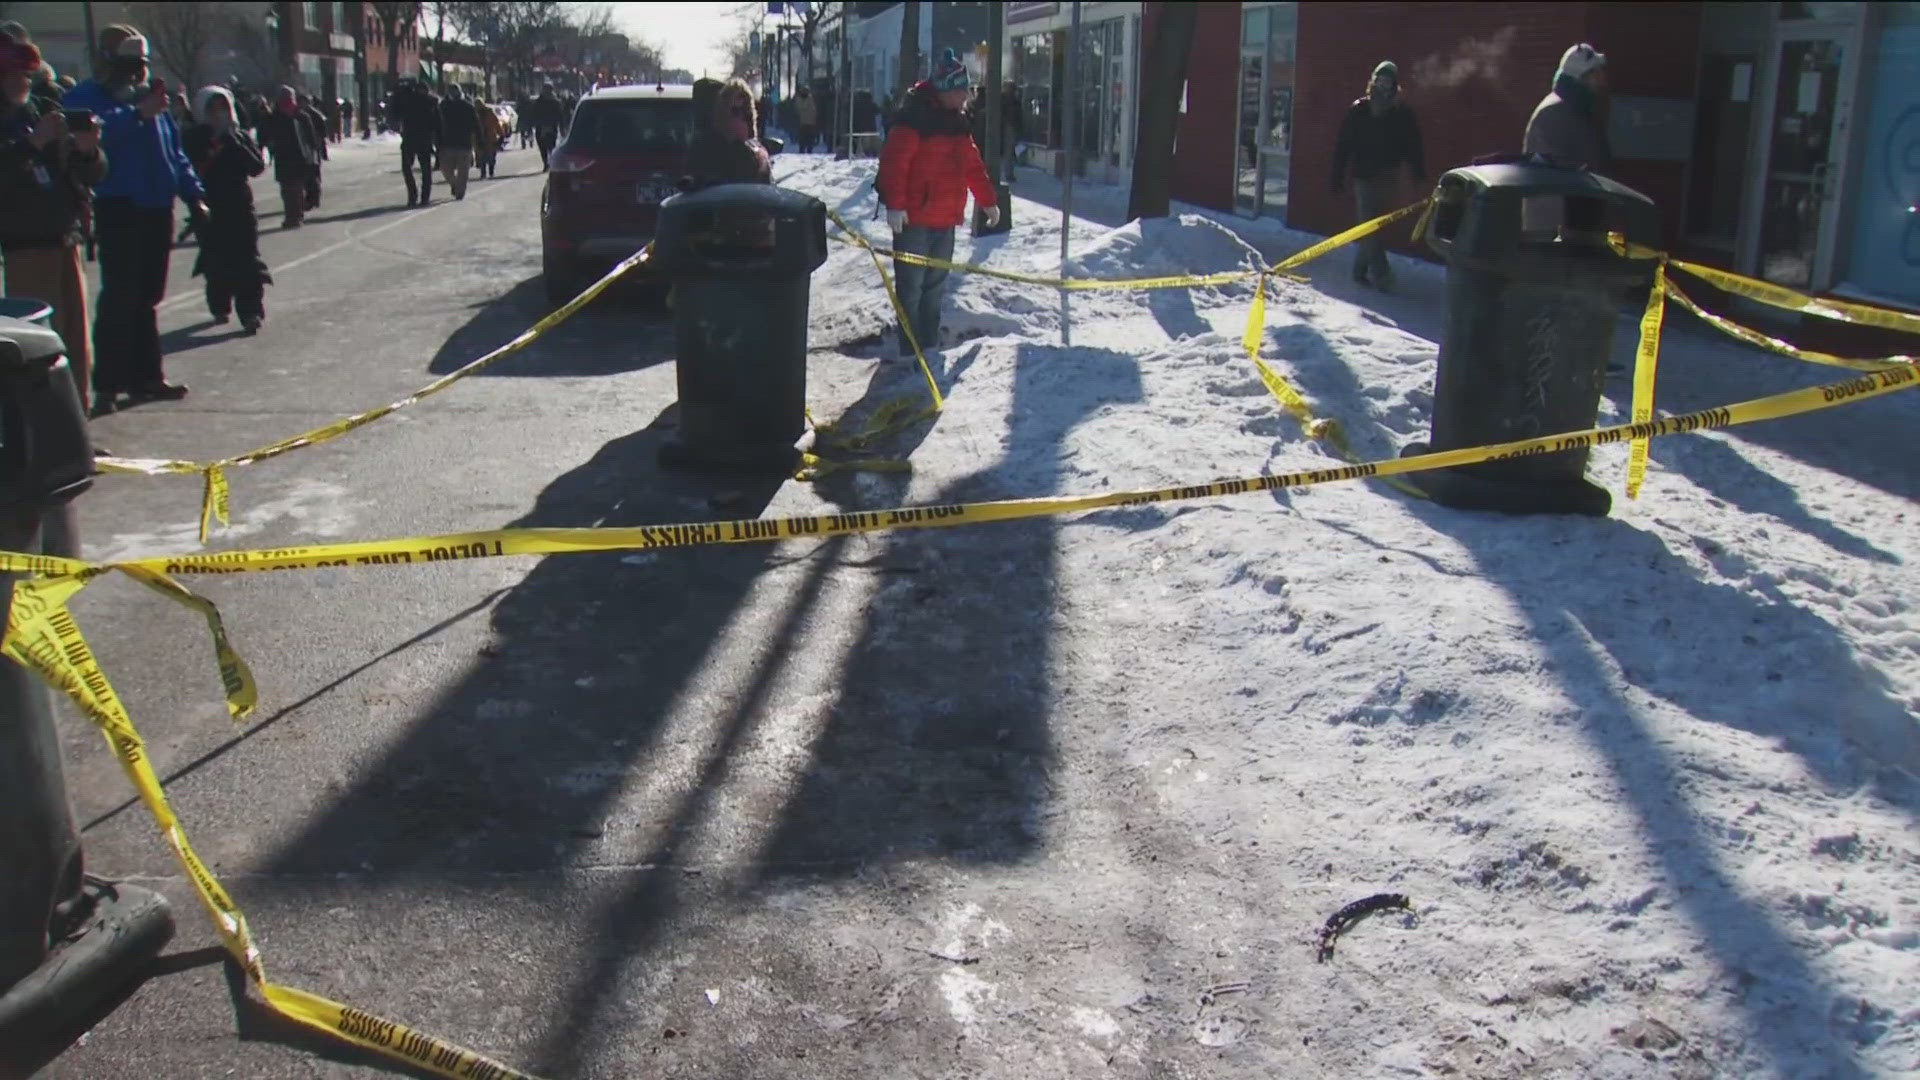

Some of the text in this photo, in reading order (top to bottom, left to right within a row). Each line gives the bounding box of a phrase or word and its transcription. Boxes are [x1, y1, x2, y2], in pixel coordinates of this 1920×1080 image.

[640, 522, 722, 548] CROSS
[730, 520, 779, 541] NOT
[338, 1008, 397, 1047] CROSS
[396, 1029, 437, 1062] NOT
